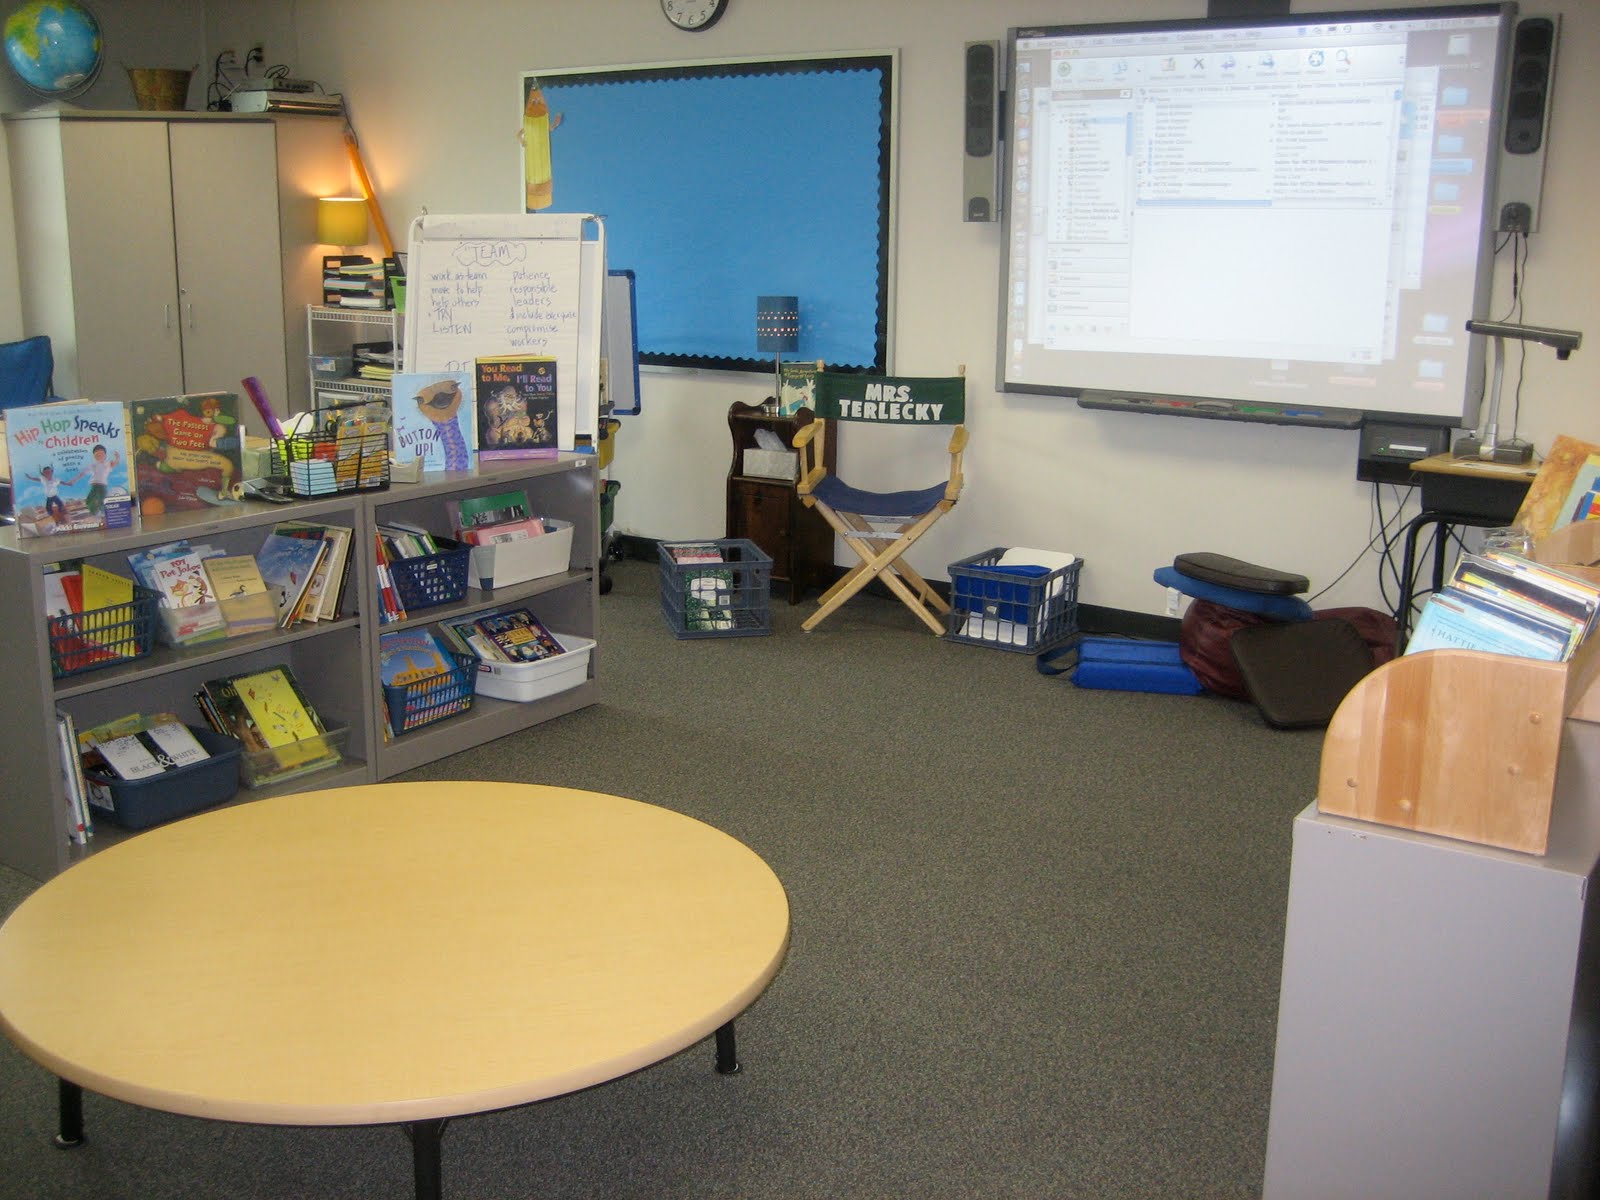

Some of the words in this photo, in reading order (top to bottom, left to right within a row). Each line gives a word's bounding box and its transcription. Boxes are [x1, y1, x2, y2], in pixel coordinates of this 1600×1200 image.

[512, 267, 551, 283] patience
[466, 280, 483, 297] help
[509, 280, 558, 297] responsible
[512, 294, 552, 307] leaders
[506, 324, 559, 341] compromise
[510, 338, 548, 348] workers
[481, 364, 498, 373] You
[500, 363, 522, 373] Read
[481, 374, 491, 382] to
[530, 373, 552, 383] Read
[525, 384, 534, 393] to
[536, 383, 552, 392] You
[865, 383, 914, 403] MRS.
[839, 399, 944, 421] TERLECKY
[168, 418, 181, 427] The
[14, 427, 40, 447] Hip
[40, 418, 72, 434] Hop
[74, 415, 121, 439] Speaks
[173, 427, 192, 437] Game
[194, 431, 204, 439] on
[398, 428, 441, 448] BUTTON
[45, 434, 100, 449] Children
[172, 437, 188, 446] Two
[415, 442, 434, 456] UP!
[159, 569, 177, 579] Pet
[177, 563, 201, 577] Jokes
[129, 760, 159, 773] BLACK
